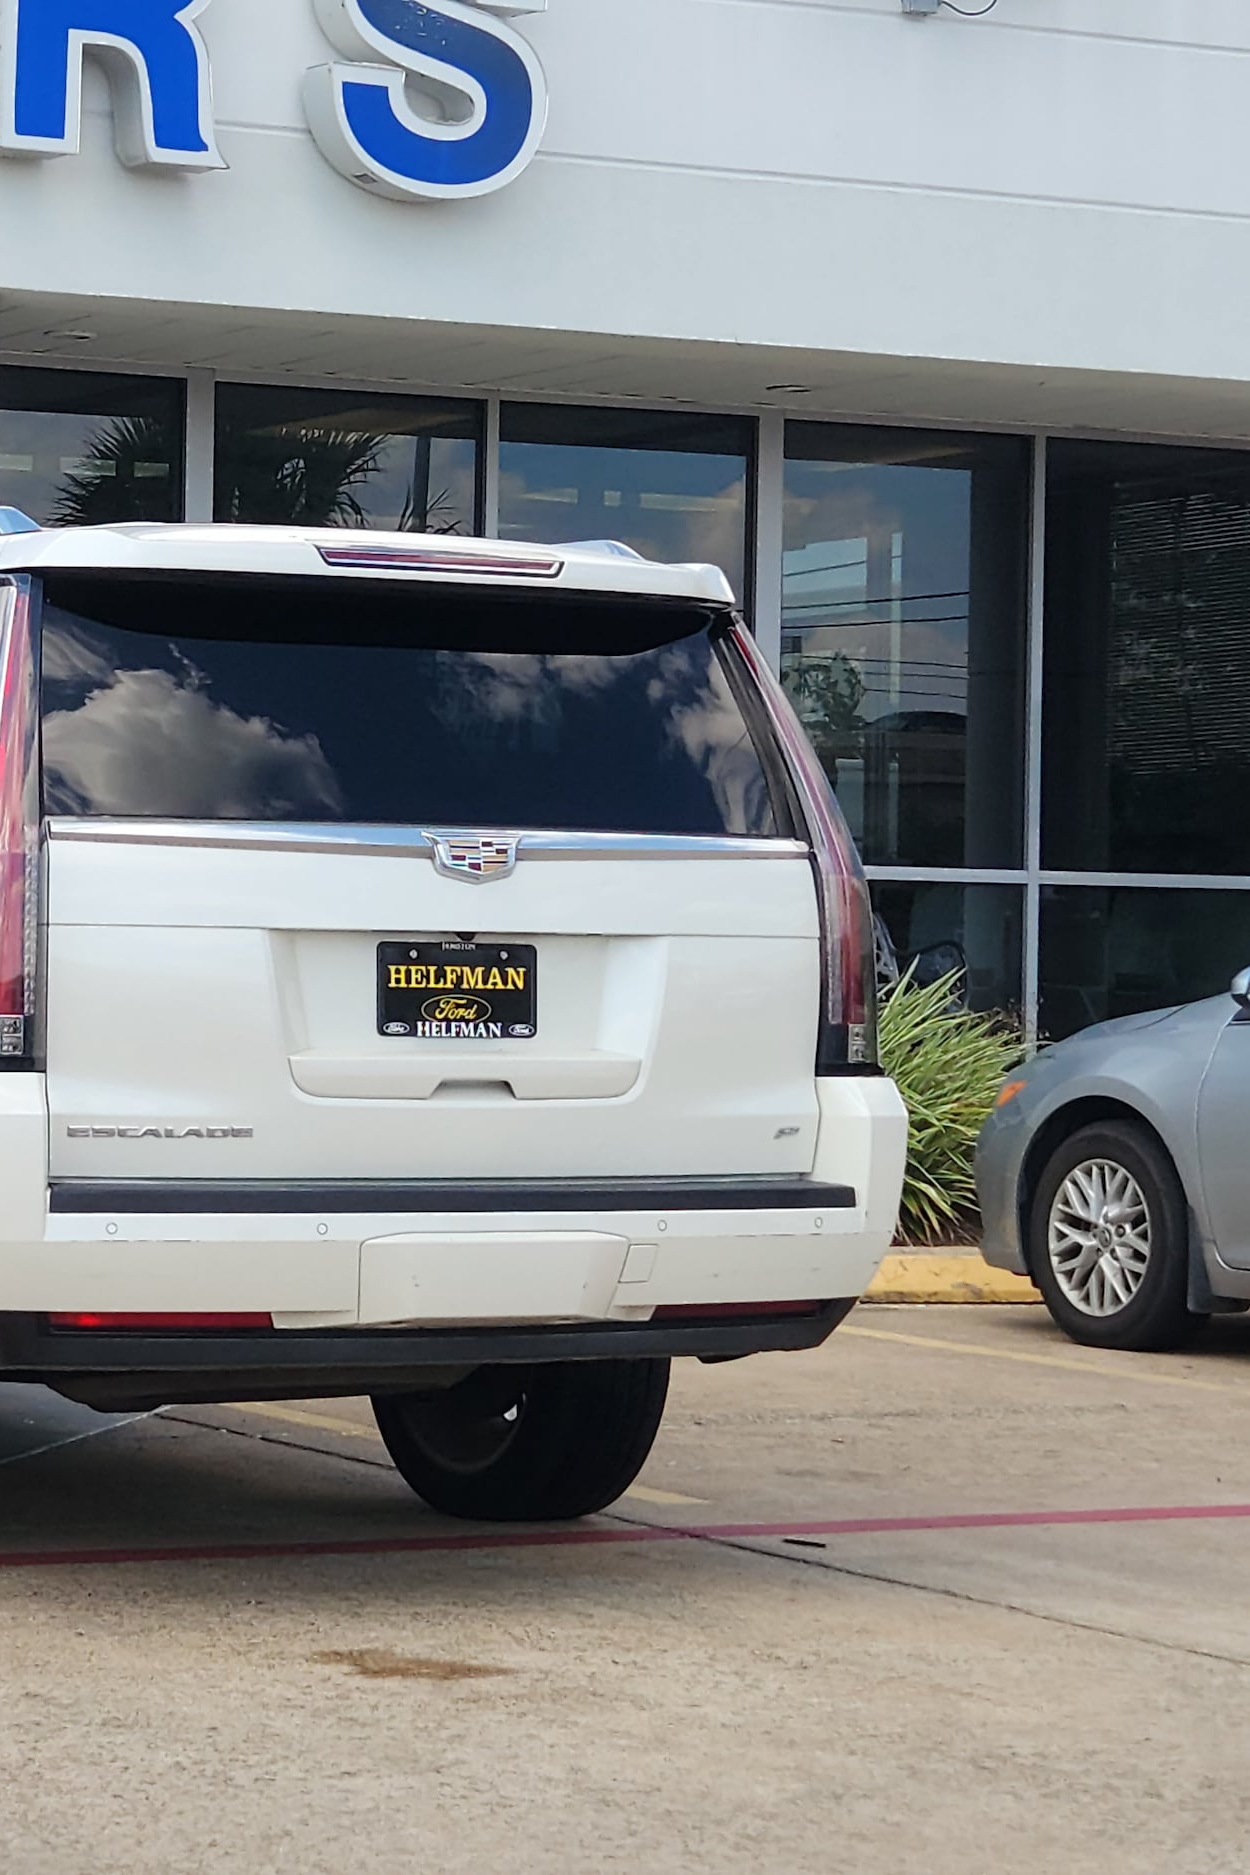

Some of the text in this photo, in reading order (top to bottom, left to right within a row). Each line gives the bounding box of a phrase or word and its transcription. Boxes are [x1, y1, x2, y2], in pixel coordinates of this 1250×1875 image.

[387, 964, 527, 990] HELFMAN
[434, 998, 478, 1020] Ford
[416, 1020, 503, 1038] HELFMAN
[66, 1124, 254, 1138] ESCALADE
